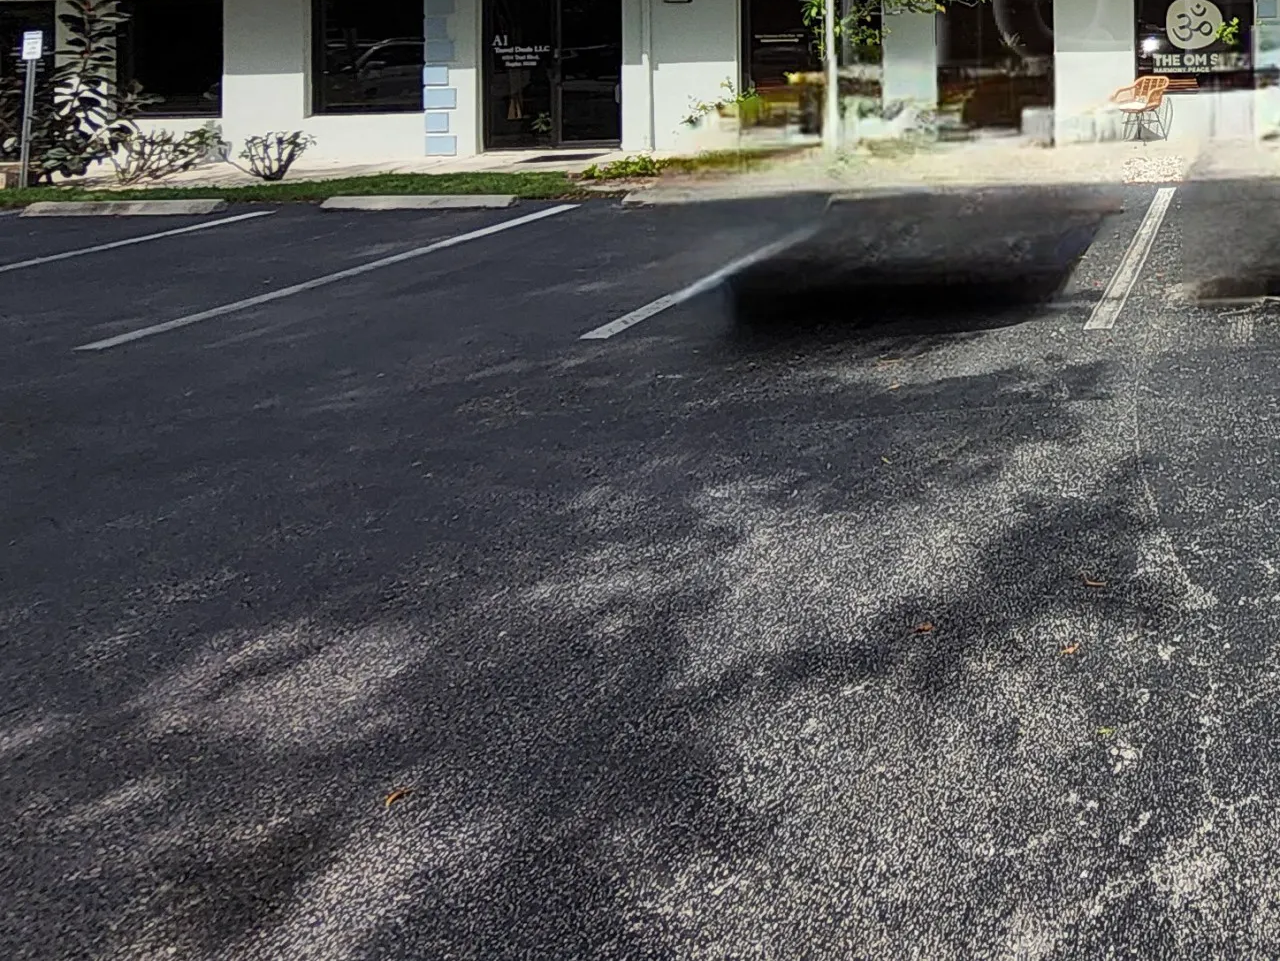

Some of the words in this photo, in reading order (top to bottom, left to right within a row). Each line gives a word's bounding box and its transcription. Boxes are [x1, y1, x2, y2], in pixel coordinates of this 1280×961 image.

[534, 44, 551, 52] LLC
[1152, 53, 1181, 67] THE
[1183, 52, 1207, 66] OM
